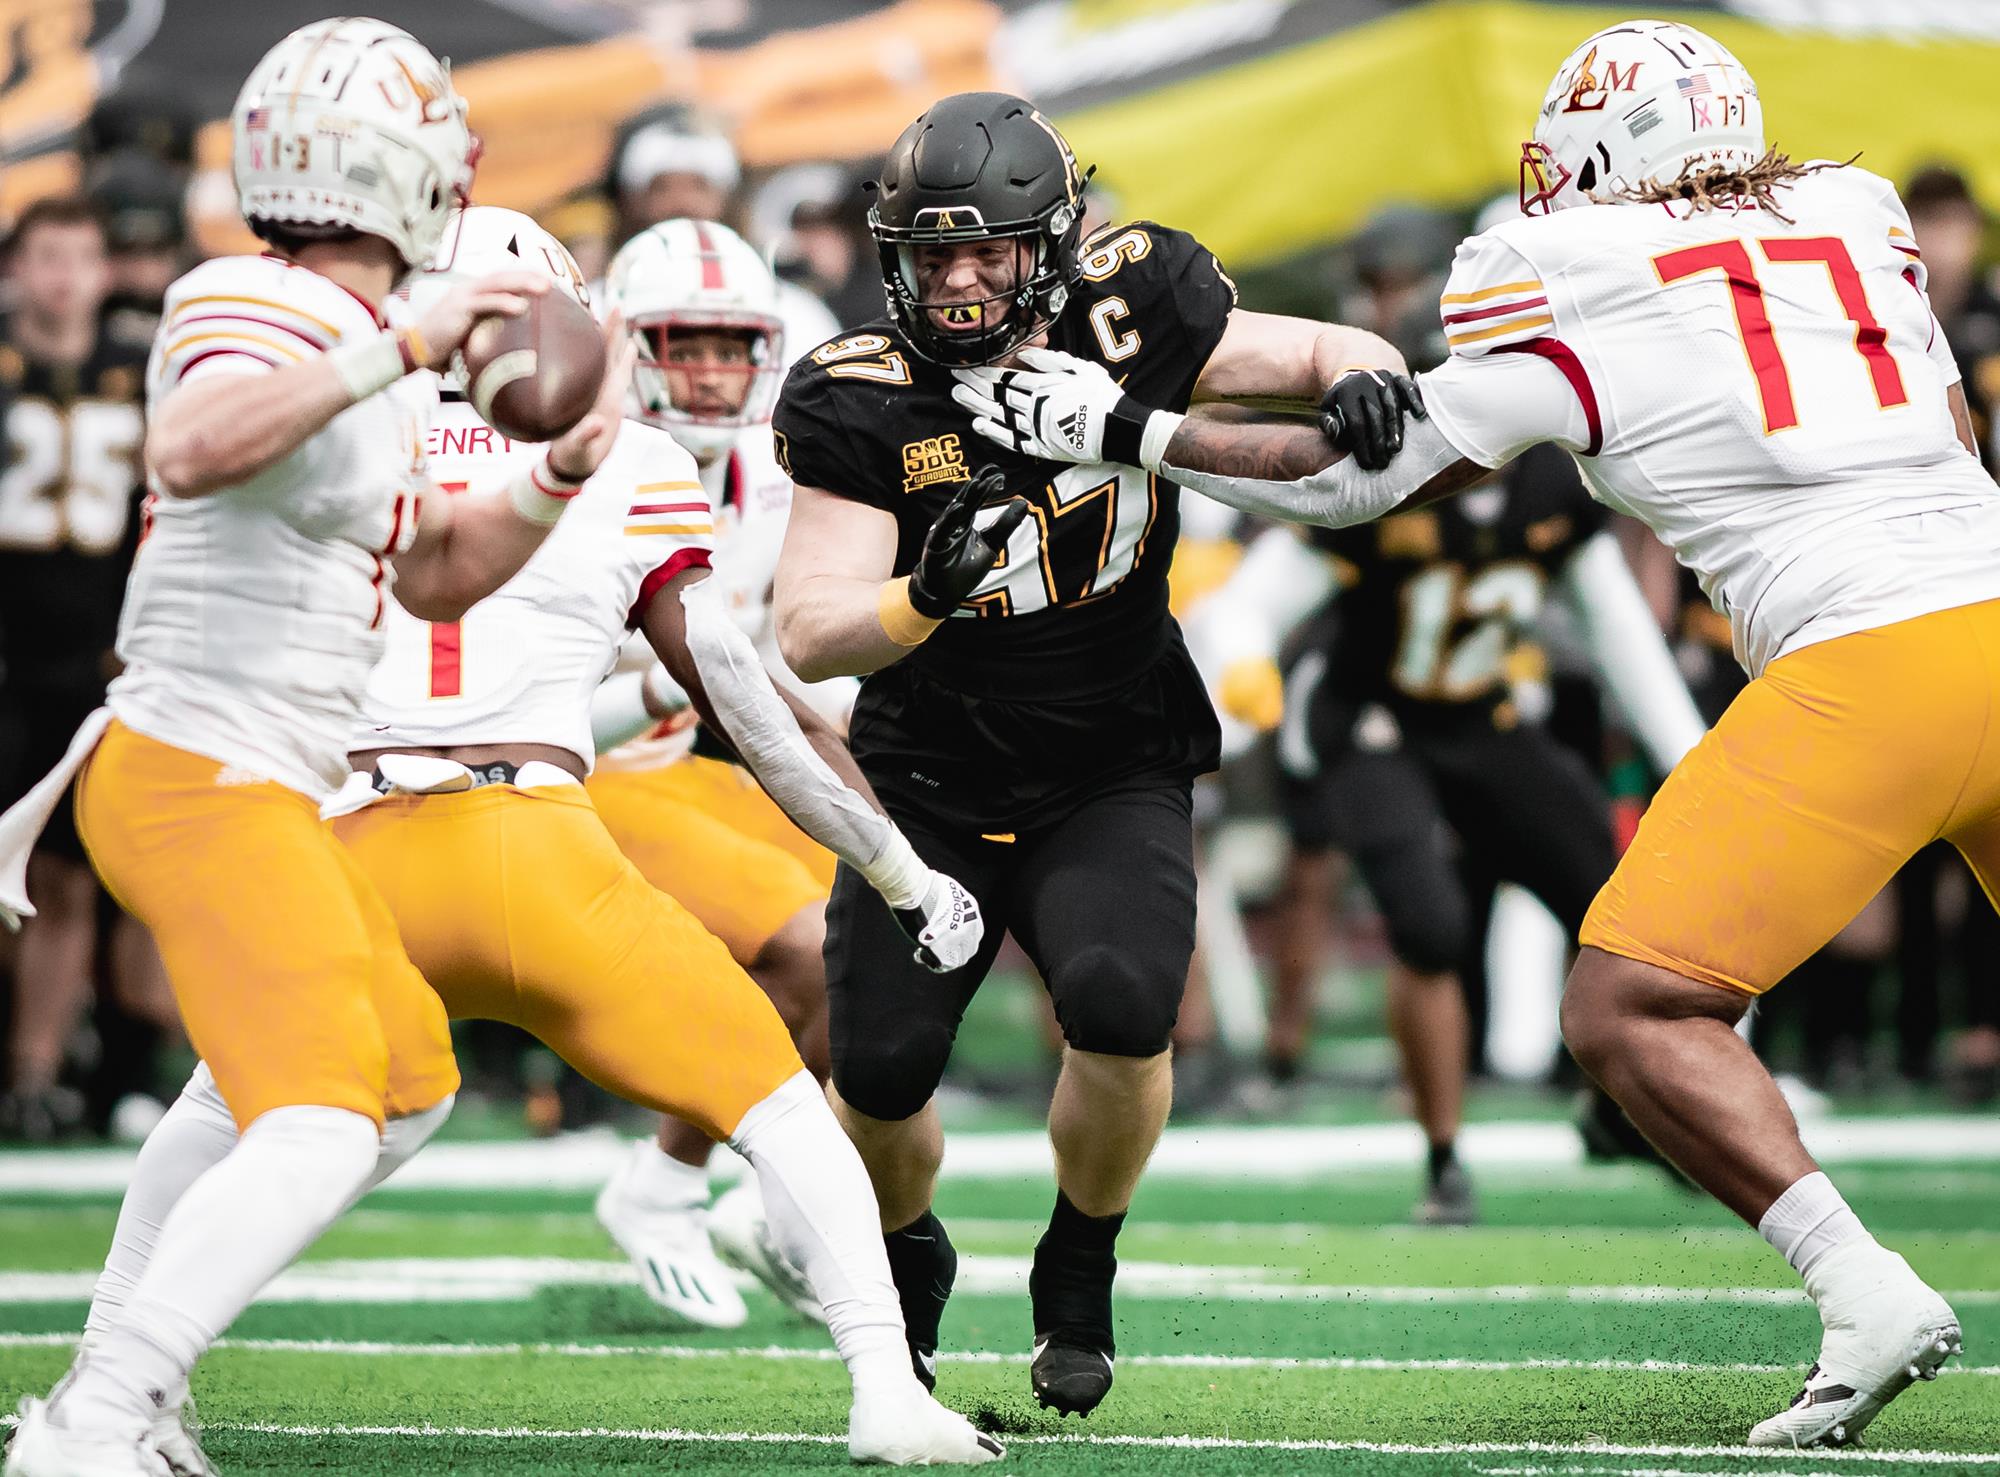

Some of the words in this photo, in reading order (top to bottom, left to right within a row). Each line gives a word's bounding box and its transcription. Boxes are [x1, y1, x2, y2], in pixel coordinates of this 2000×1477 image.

[936, 209, 955, 229] A
[1089, 295, 1142, 363] C
[1649, 236, 1910, 437] 77
[811, 334, 913, 385] 97
[1075, 404, 1088, 450] adidas
[0, 398, 146, 552] 25
[902, 433, 964, 475] SBC
[913, 466, 960, 484] GRADUATE
[1392, 562, 1543, 702] 12
[949, 881, 964, 931] adidas
